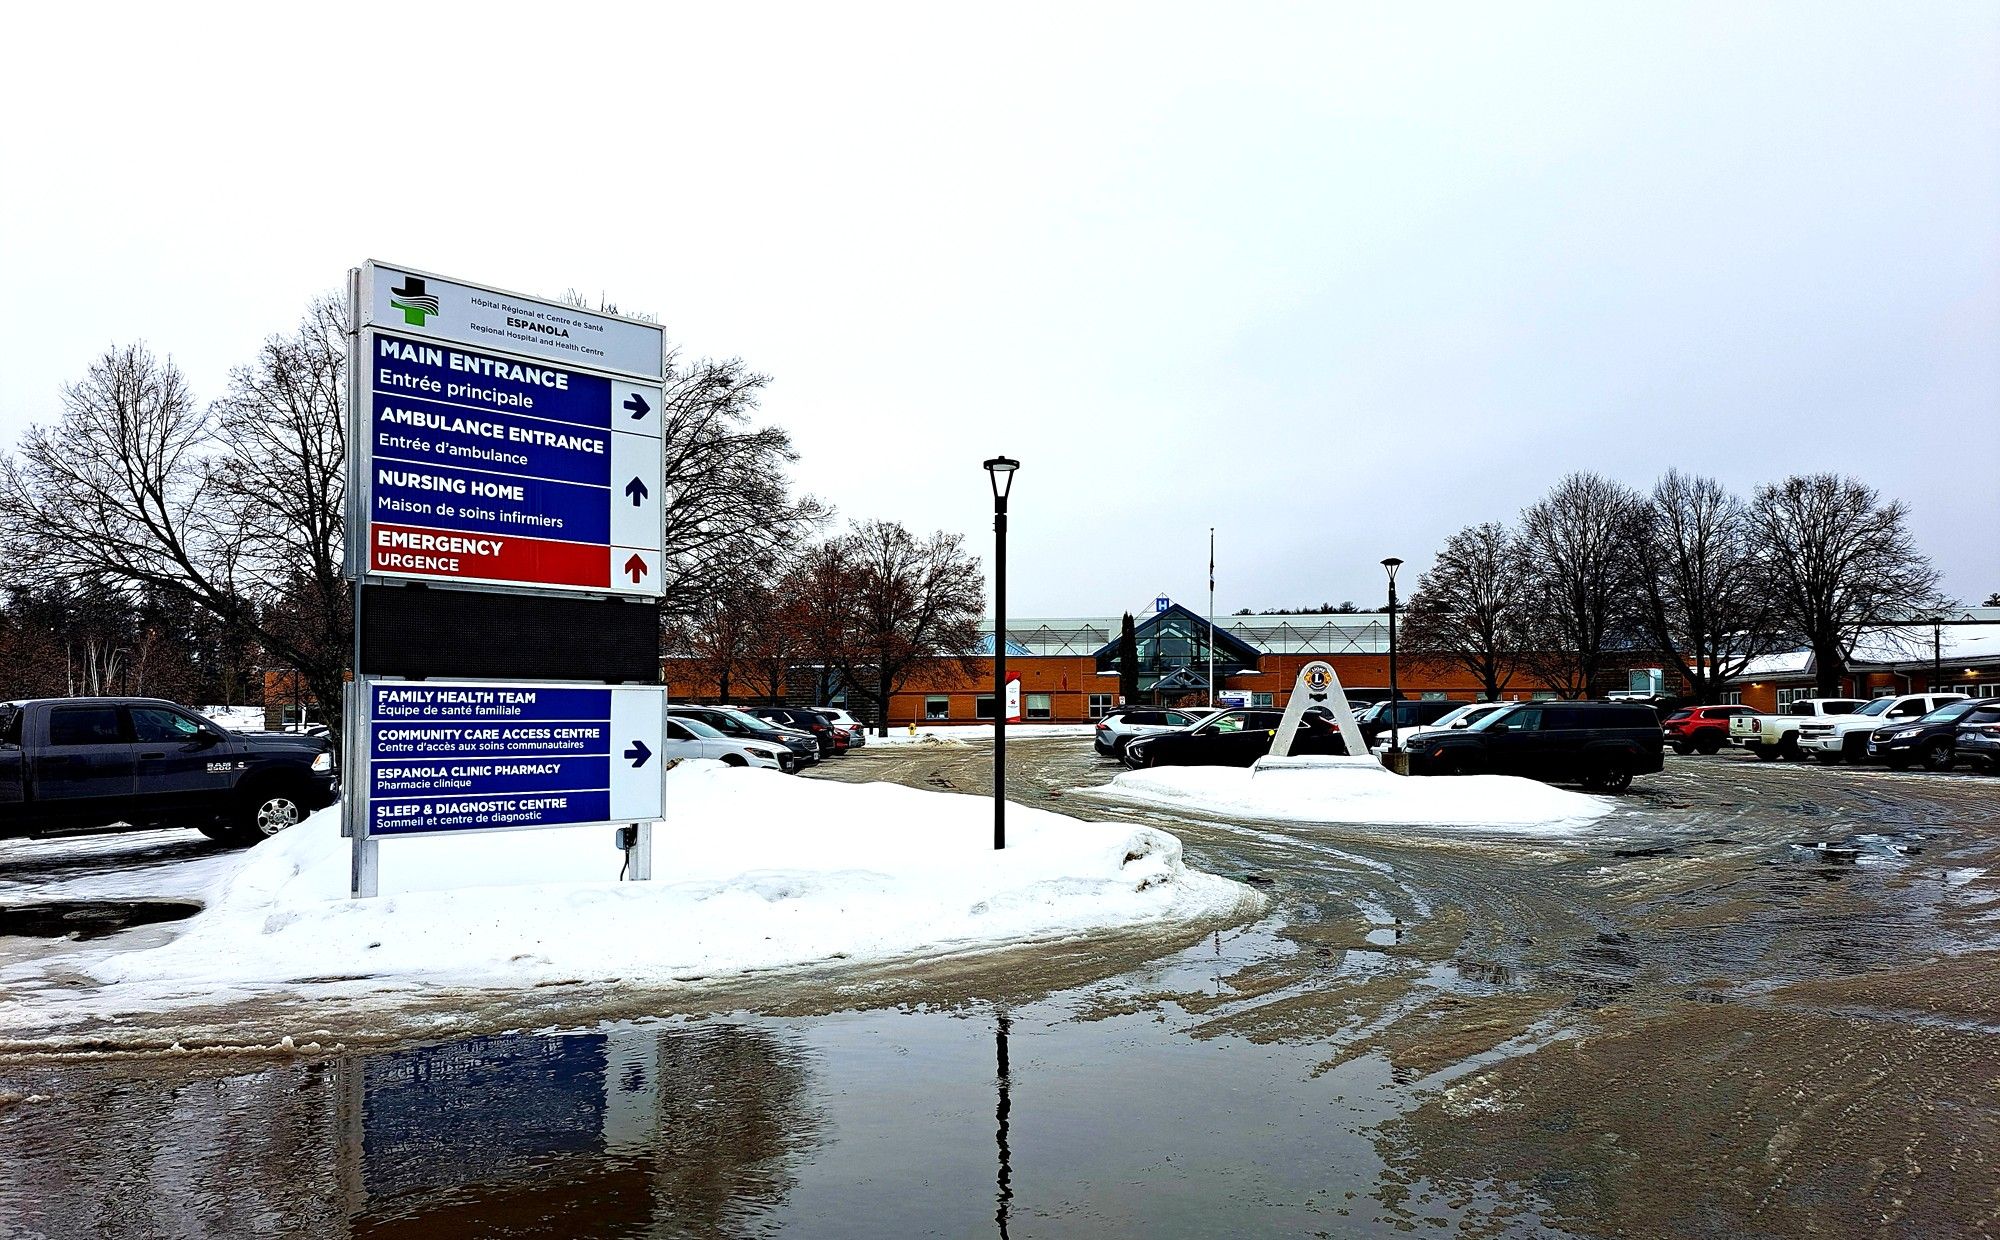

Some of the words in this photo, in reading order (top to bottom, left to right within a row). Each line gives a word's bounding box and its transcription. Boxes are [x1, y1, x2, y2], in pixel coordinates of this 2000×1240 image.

[471, 297, 499, 309] Hôpital
[502, 304, 534, 318] Régional
[546, 314, 570, 325] Centre
[572, 320, 582, 328] de
[584, 322, 604, 332] Santé
[506, 317, 569, 338] ESPANOLA
[470, 323, 504, 336] Regional
[506, 330, 538, 342] Hospital
[540, 338, 554, 346] and
[556, 342, 578, 351] Health
[580, 346, 604, 356] Centre
[380, 339, 443, 367] MAIN
[449, 353, 569, 391] ENTRANCE
[379, 368, 442, 393] Entrée
[447, 382, 534, 408] principale
[380, 406, 504, 439] AMBULANCE
[508, 426, 604, 455] ENTRANCE
[378, 432, 431, 452] Entrée
[434, 441, 529, 466] d'ambulance
[378, 469, 466, 495] NURSING
[470, 481, 525, 502] HOME
[378, 496, 432, 515] Maison
[436, 502, 455, 517] de
[458, 506, 496, 522] soins
[499, 511, 564, 529] infirmiers
[377, 530, 504, 558] EMERGENCY
[377, 553, 460, 572] URGENCE
[1158, 600, 1167, 610] H
[1315, 674, 1322, 682] L
[378, 690, 434, 704] FAMILY
[437, 691, 493, 704] HEALTH
[497, 692, 537, 704] TEAM
[378, 702, 420, 717] Équipe
[422, 704, 438, 716] de
[440, 704, 473, 716] santé
[474, 704, 522, 716] familiale
[377, 729, 462, 742] COMMUNITY
[464, 729, 500, 740] CARE
[502, 728, 551, 740] ACCESS
[553, 728, 600, 740] CENTRE
[377, 741, 414, 753] Centre
[416, 740, 456, 752] d'accès
[458, 742, 477, 752] aux
[478, 740, 505, 751] soins
[506, 740, 585, 750] communautaires
[376, 766, 448, 780] ESPANOLA
[451, 766, 492, 778] CLINIC
[494, 763, 561, 777] PHARMACY
[376, 779, 432, 791] Pharmacie
[434, 777, 472, 791] clinique
[376, 803, 420, 818] SLEEP
[423, 802, 432, 816] &
[435, 799, 517, 815] DIAGNOSTIC
[518, 797, 568, 811] CENTRE
[376, 817, 424, 829] Sommeil
[426, 815, 438, 826] et
[440, 814, 474, 826] centre
[476, 812, 490, 824] de
[491, 810, 542, 825] diagnostic
